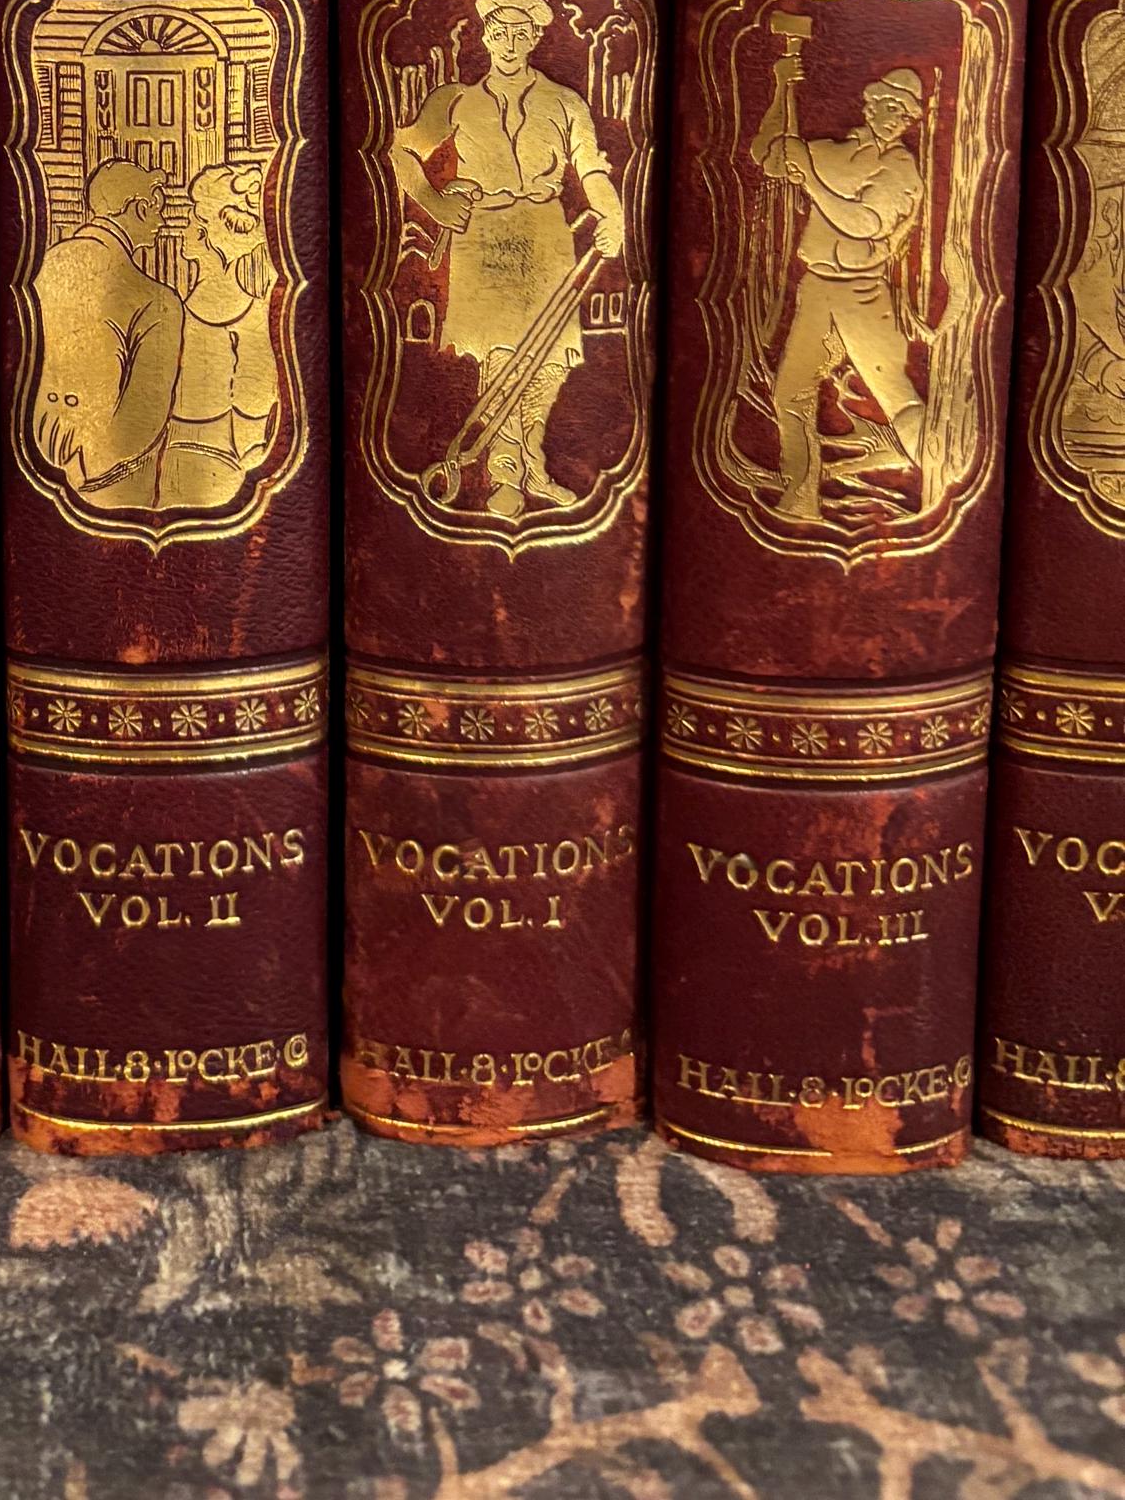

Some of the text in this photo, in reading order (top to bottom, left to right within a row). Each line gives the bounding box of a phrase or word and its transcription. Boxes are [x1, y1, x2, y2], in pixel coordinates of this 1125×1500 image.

[19, 828, 305, 878] VOCATIONS
[358, 824, 634, 880] VOCATIONS
[687, 842, 973, 896] VOCATIONS
